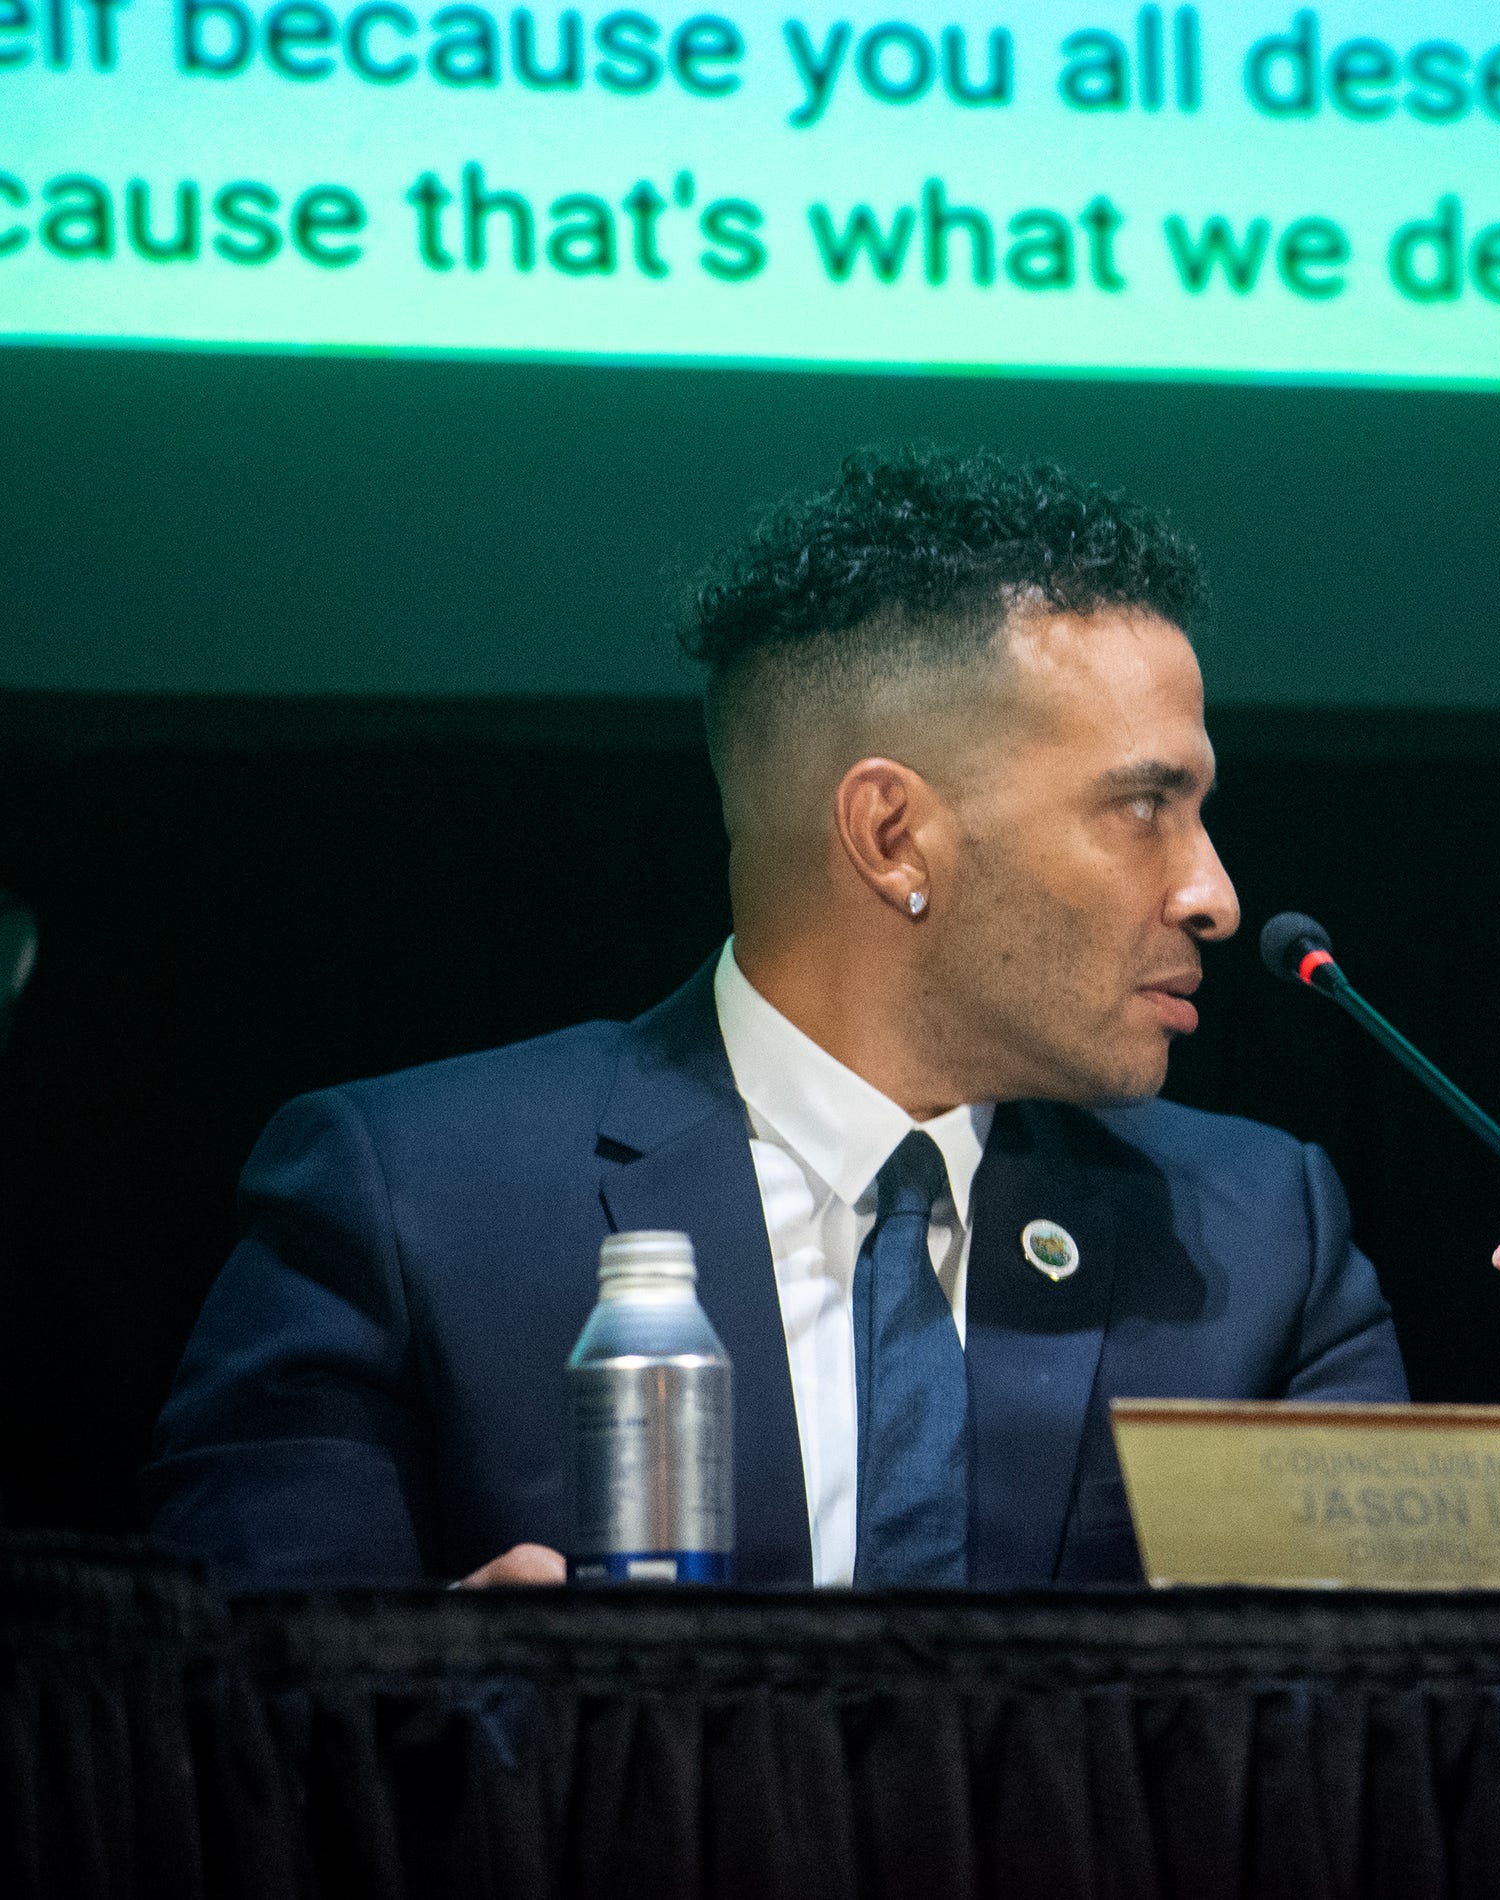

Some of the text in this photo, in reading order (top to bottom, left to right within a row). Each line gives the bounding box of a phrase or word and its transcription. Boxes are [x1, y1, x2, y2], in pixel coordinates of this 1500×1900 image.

[176, 0, 743, 95] because
[785, 20, 1012, 126] you
[1060, 5, 1200, 112] all
[410, 163, 766, 280] that's
[811, 180, 1123, 290] what
[1167, 215, 1349, 299] we
[1291, 1487, 1470, 1528] JASON
